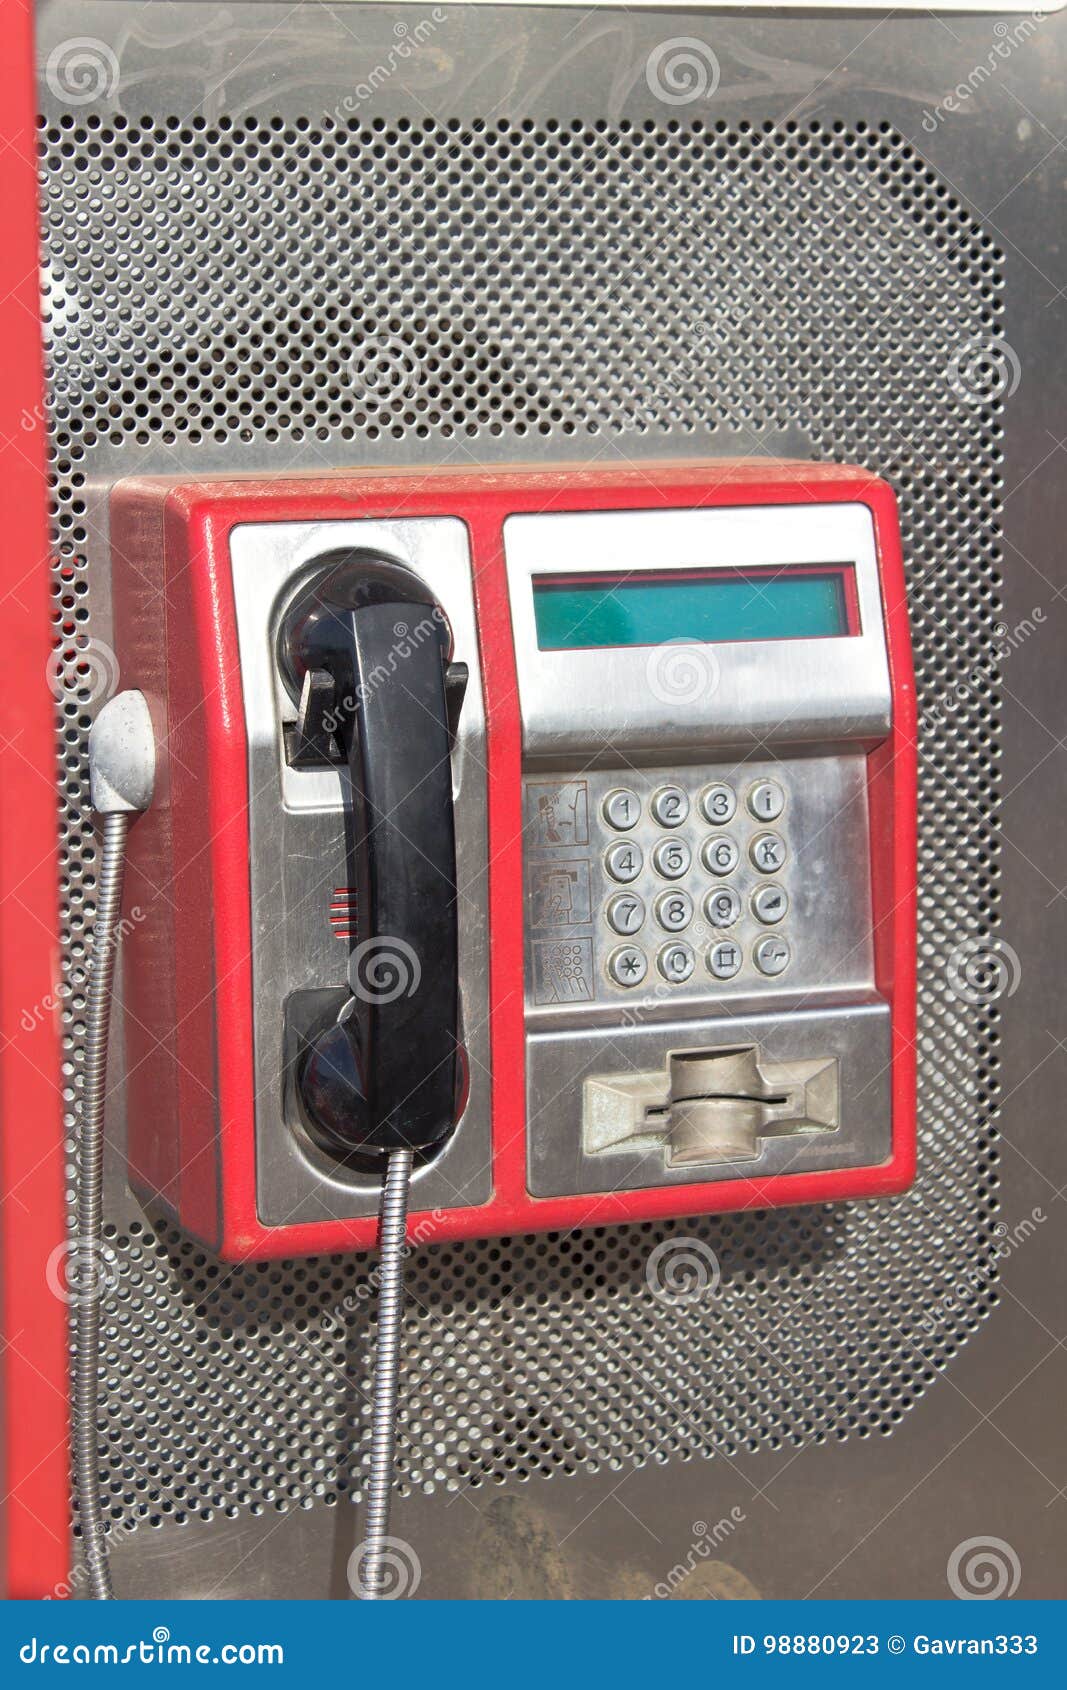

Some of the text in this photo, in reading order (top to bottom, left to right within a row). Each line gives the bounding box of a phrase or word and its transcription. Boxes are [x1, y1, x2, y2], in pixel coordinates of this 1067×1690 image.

[620, 790, 772, 822] 1 2 3 i
[619, 842, 778, 873] 4 5 6 K
[622, 896, 732, 926] 7 8 9
[671, 951, 688, 973] 0
